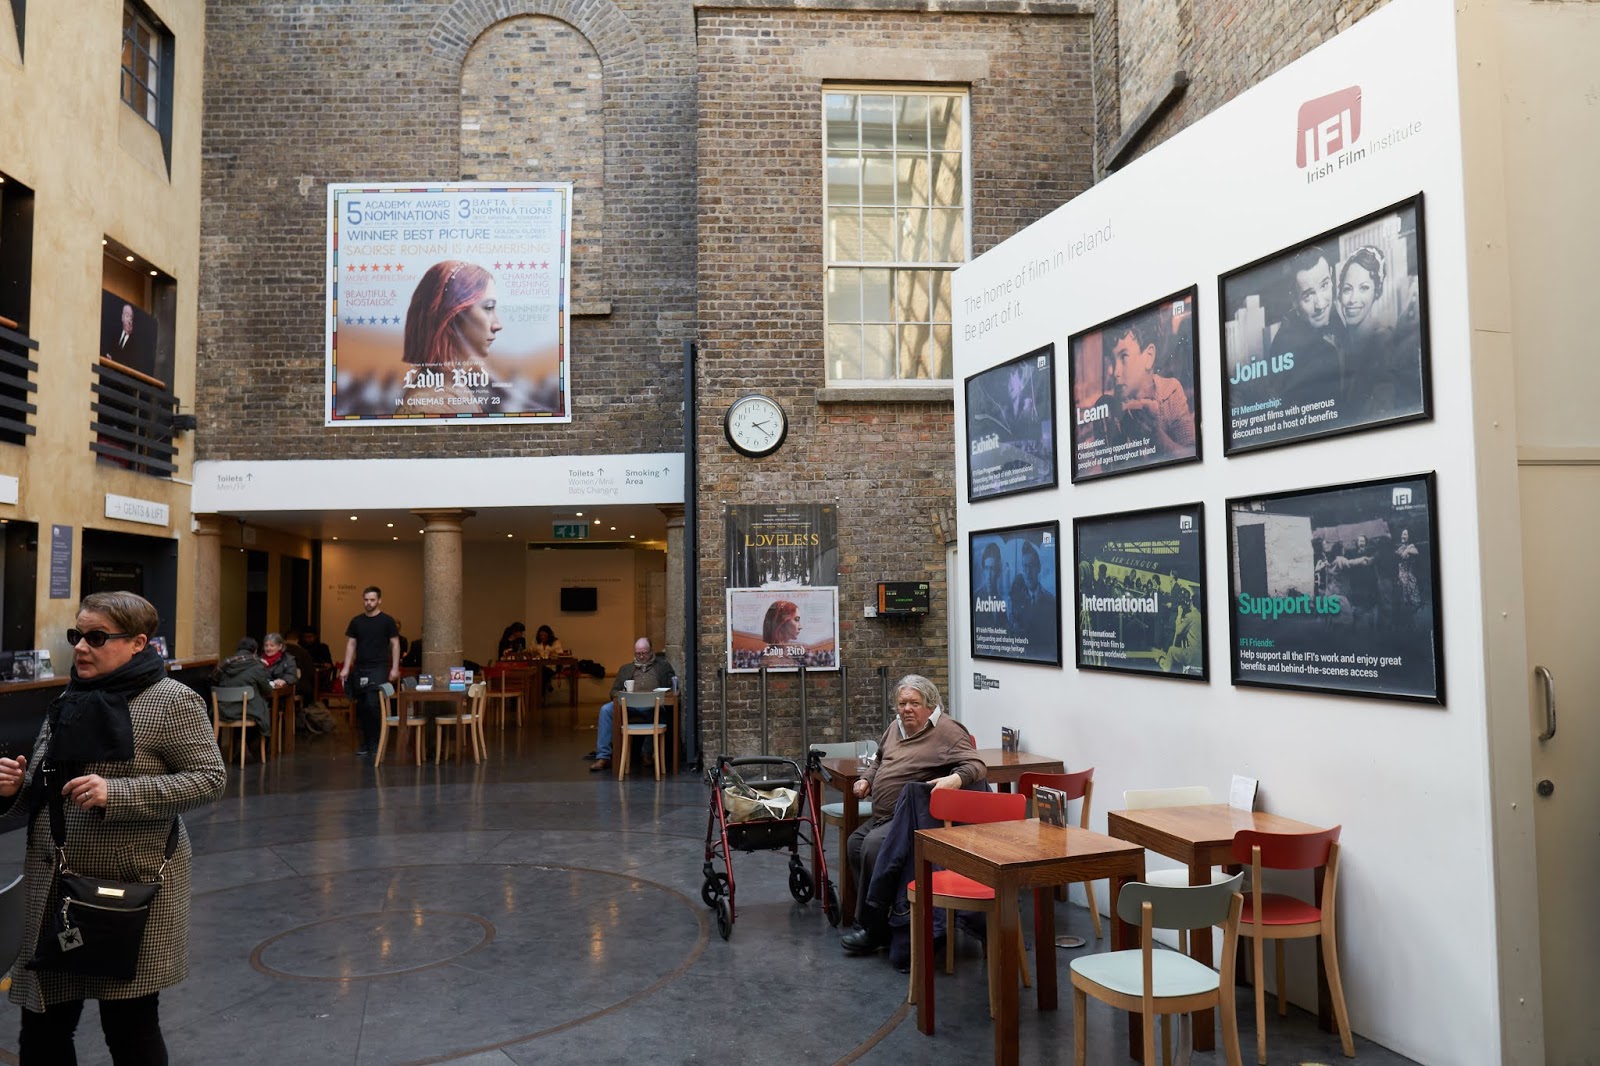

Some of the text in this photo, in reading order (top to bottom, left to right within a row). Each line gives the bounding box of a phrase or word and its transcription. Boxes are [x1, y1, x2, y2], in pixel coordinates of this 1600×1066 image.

[1307, 121, 1422, 184] Irish Film Institute
[365, 200, 450, 209] ACADEMY AWARD
[458, 199, 471, 219] 3
[472, 199, 507, 207] BAFTA
[472, 207, 553, 215] NOMINATIONS
[347, 201, 362, 225] 5
[365, 210, 450, 221] NOMINATIONS
[347, 228, 490, 241] WINNER BEST PICTURE
[401, 244, 448, 255] RONAN
[452, 243, 462, 254] IS
[466, 243, 550, 255] MESMERISING
[964, 218, 1115, 316] The home of film in Ireland.
[390, 290, 397, 298] &
[965, 300, 1024, 342] Be part of it.
[1230, 352, 1295, 385] Join us
[402, 367, 489, 393] Lady Bird
[395, 396, 501, 406] IN CINEMAS FEBRUARY 23
[1231, 398, 1282, 417] IFI Membership:
[1076, 403, 1109, 426] Learn
[1231, 398, 1335, 428] Enjoy great films with generous
[1232, 426, 1263, 439] discounts
[1263, 422, 1276, 433] and
[1282, 418, 1299, 429] host
[1299, 414, 1307, 425] of
[1308, 410, 1338, 424] benefits
[971, 433, 1000, 455] Exhibit
[1112, 440, 1143, 453] opportunities
[1103, 457, 1113, 465] ages
[1113, 450, 1139, 461] throughout
[1139, 445, 1156, 456] Ireland
[217, 474, 243, 482] Toilets
[568, 469, 594, 477] Toilets
[625, 469, 660, 478] Smoking
[568, 486, 619, 495] Baby Changing
[124, 503, 145, 517] GENTS
[151, 508, 163, 519] LIFT
[745, 533, 819, 547] LOVELESS
[1126, 559, 1159, 570] LINGUS
[975, 596, 1007, 613] Archive
[1082, 592, 1159, 613] International
[1238, 592, 1341, 619] Support us
[1240, 638, 1275, 647] IFI Friends:
[763, 645, 805, 658] Lady Bird
[1240, 649, 1402, 667] Help support all the IFI's work and enjoy great
[1240, 660, 1379, 678] benefits and behind-the-scenes access
